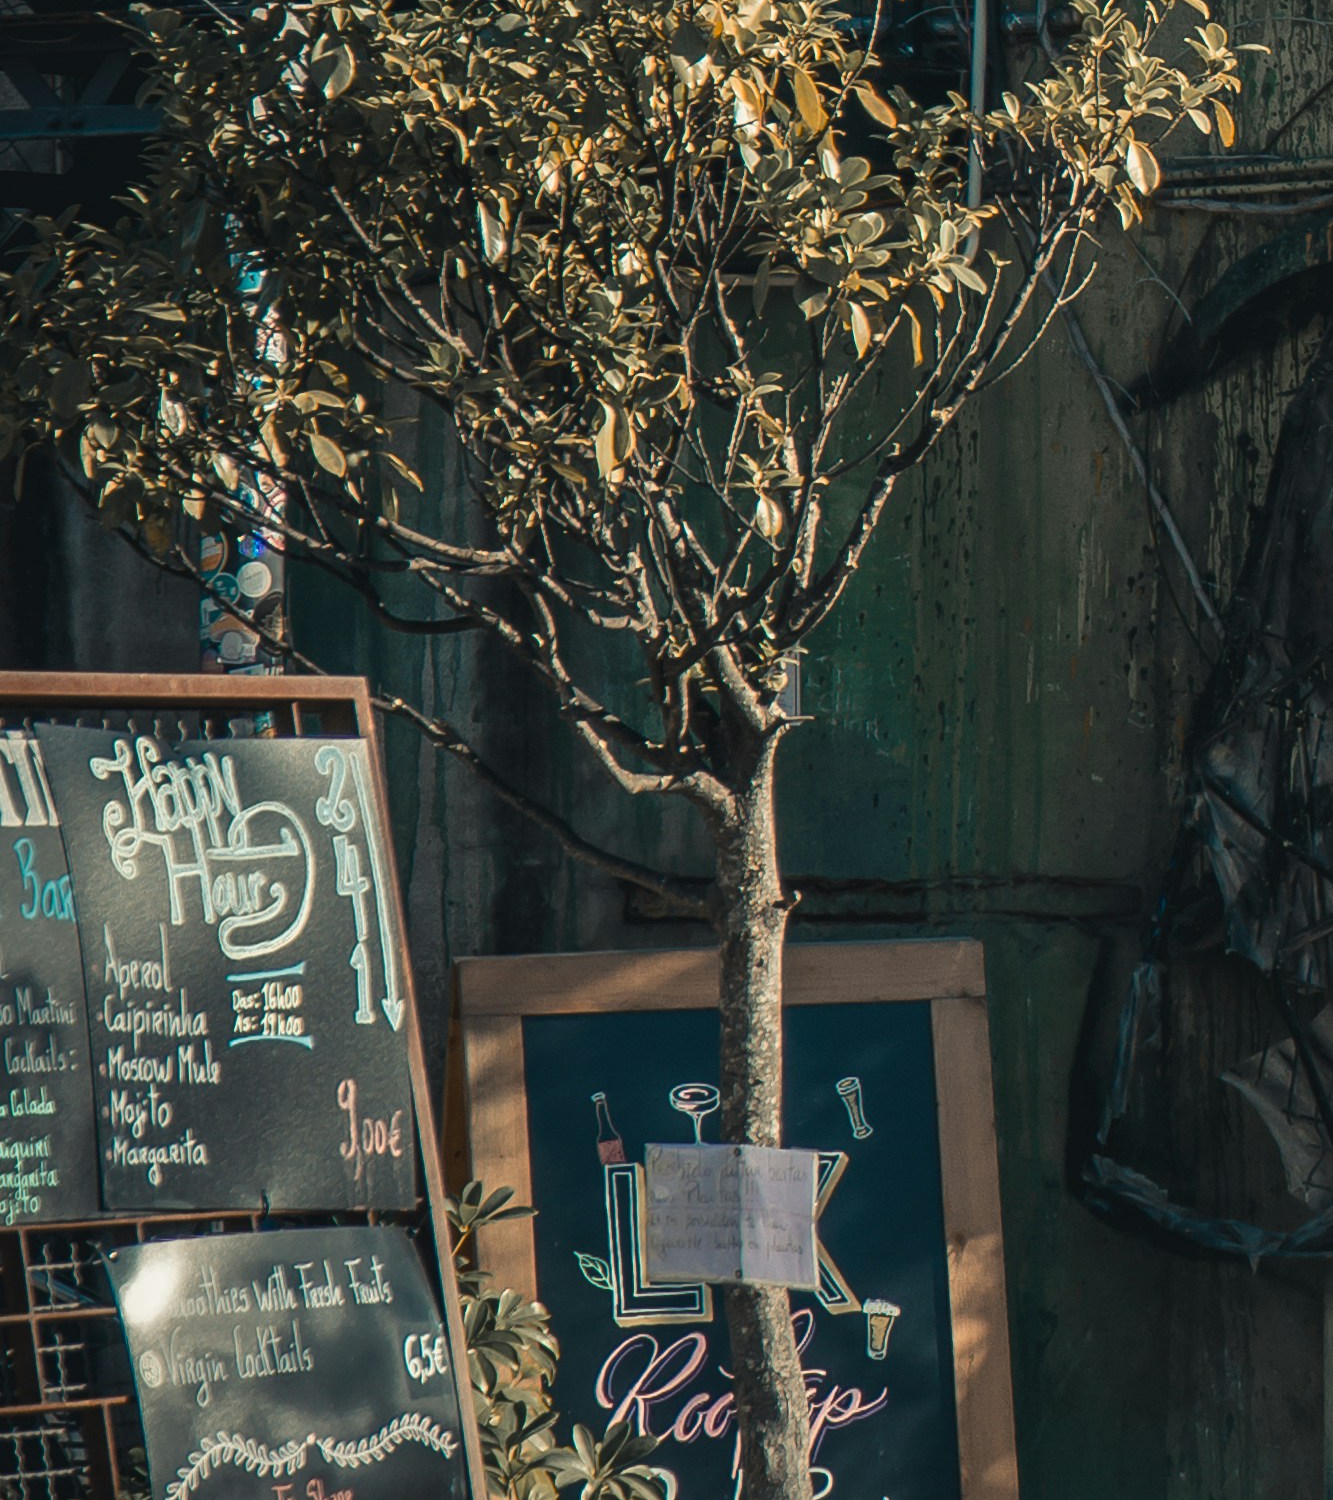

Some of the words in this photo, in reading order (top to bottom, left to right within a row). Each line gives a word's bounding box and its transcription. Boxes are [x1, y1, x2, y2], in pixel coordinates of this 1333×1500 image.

[104, 923, 174, 1000] Aperol
[15, 985, 78, 1026] Martini
[261, 982, 303, 1011] 16h00
[104, 988, 209, 1051] Caipirinha
[260, 1012, 305, 1037] 19h00
[107, 1045, 172, 1084] Moscow
[178, 1039, 221, 1085] Mule
[10, 1085, 57, 1117] Colada
[109, 1084, 174, 1138] Mojito
[0, 1134, 51, 1172] aiquiri
[113, 1128, 209, 1187] Margarita
[0, 1160, 59, 1200] argarita
[0, 1188, 41, 1227] ojito
[294, 1258, 345, 1309] Fresh
[344, 1254, 393, 1306] Fruits
[160, 1324, 230, 1408] Virgin
[233, 1318, 315, 1380] Cocktails
